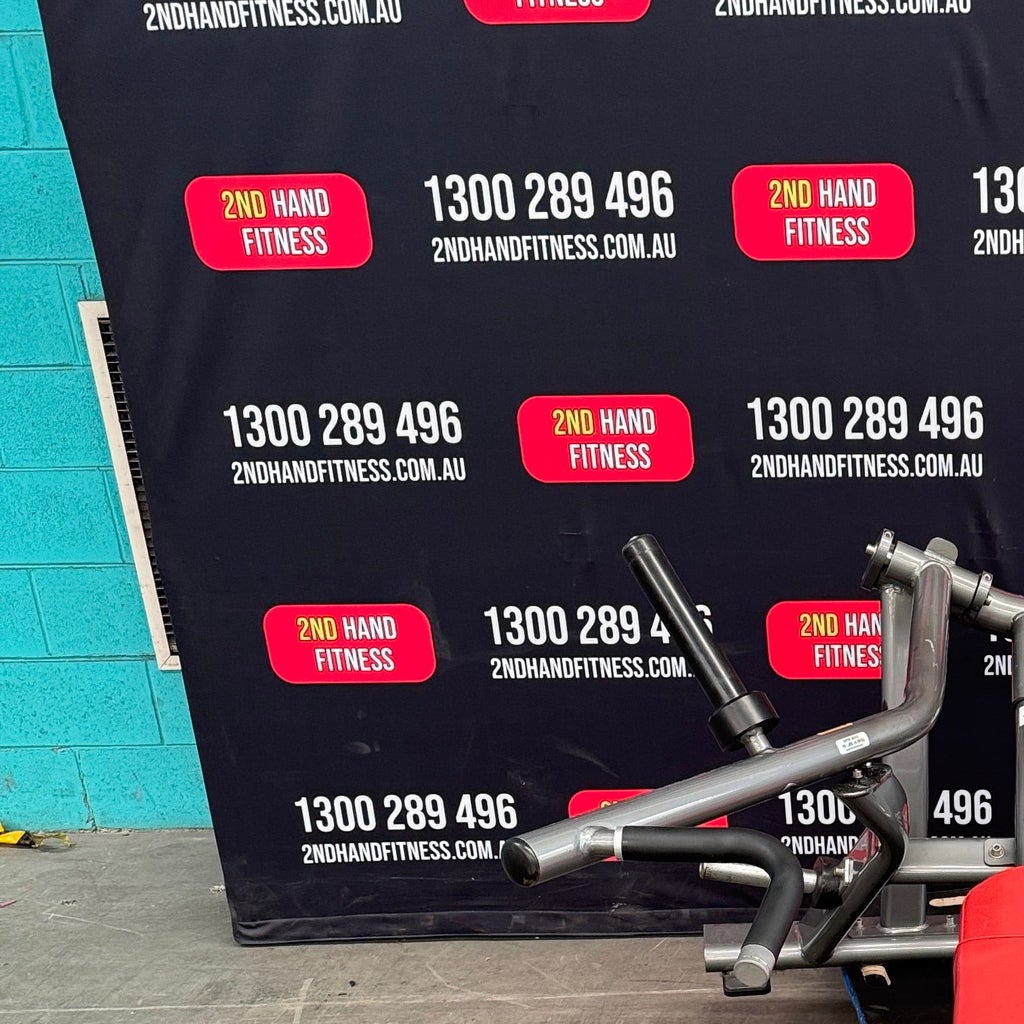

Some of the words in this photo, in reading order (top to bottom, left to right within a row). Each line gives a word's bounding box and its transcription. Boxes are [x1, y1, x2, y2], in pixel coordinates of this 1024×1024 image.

[143, 0, 403, 32] 2NDHANDFITNESS.COM.AU
[221, 190, 267, 219] 2ND
[271, 188, 330, 218] HAND
[423, 172, 516, 222] 1300
[524, 171, 595, 220] 289
[604, 169, 674, 219] 496
[769, 179, 812, 209] 2ND
[818, 178, 877, 208] HAND
[241, 226, 328, 256] FITNESS
[785, 216, 870, 246] FITNESS
[431, 232, 677, 263] 2NDHANDFITNESS.COM.AU
[223, 403, 311, 448] 1300
[318, 401, 387, 446] 289
[395, 400, 463, 445] 496
[552, 409, 594, 435] 2ND
[599, 408, 656, 435] HAND
[747, 396, 833, 441] 1300
[843, 395, 909, 441] 289
[918, 395, 984, 440] 496
[231, 457, 466, 485] 2NDHANDFITNESS.COM.AU
[569, 442, 652, 470] FITNESS
[750, 453, 983, 478] 2NDHANDFITNESS.COM.AU
[296, 617, 338, 641] 2ND
[341, 615, 397, 640] HAND
[483, 605, 569, 646] 1300
[576, 604, 641, 645] 289
[799, 613, 839, 637] 2ND
[844, 612, 882, 637] HAN
[314, 647, 395, 672] FITNESS
[490, 656, 696, 679] 2NDHANDFITNESS.COM.
[813, 643, 882, 669] FITNES
[294, 794, 377, 833] 1300
[383, 793, 447, 831] 289
[455, 793, 518, 830] 496
[933, 788, 993, 825] 496
[301, 839, 505, 864] 2NDHANDFITNESS.COM.
